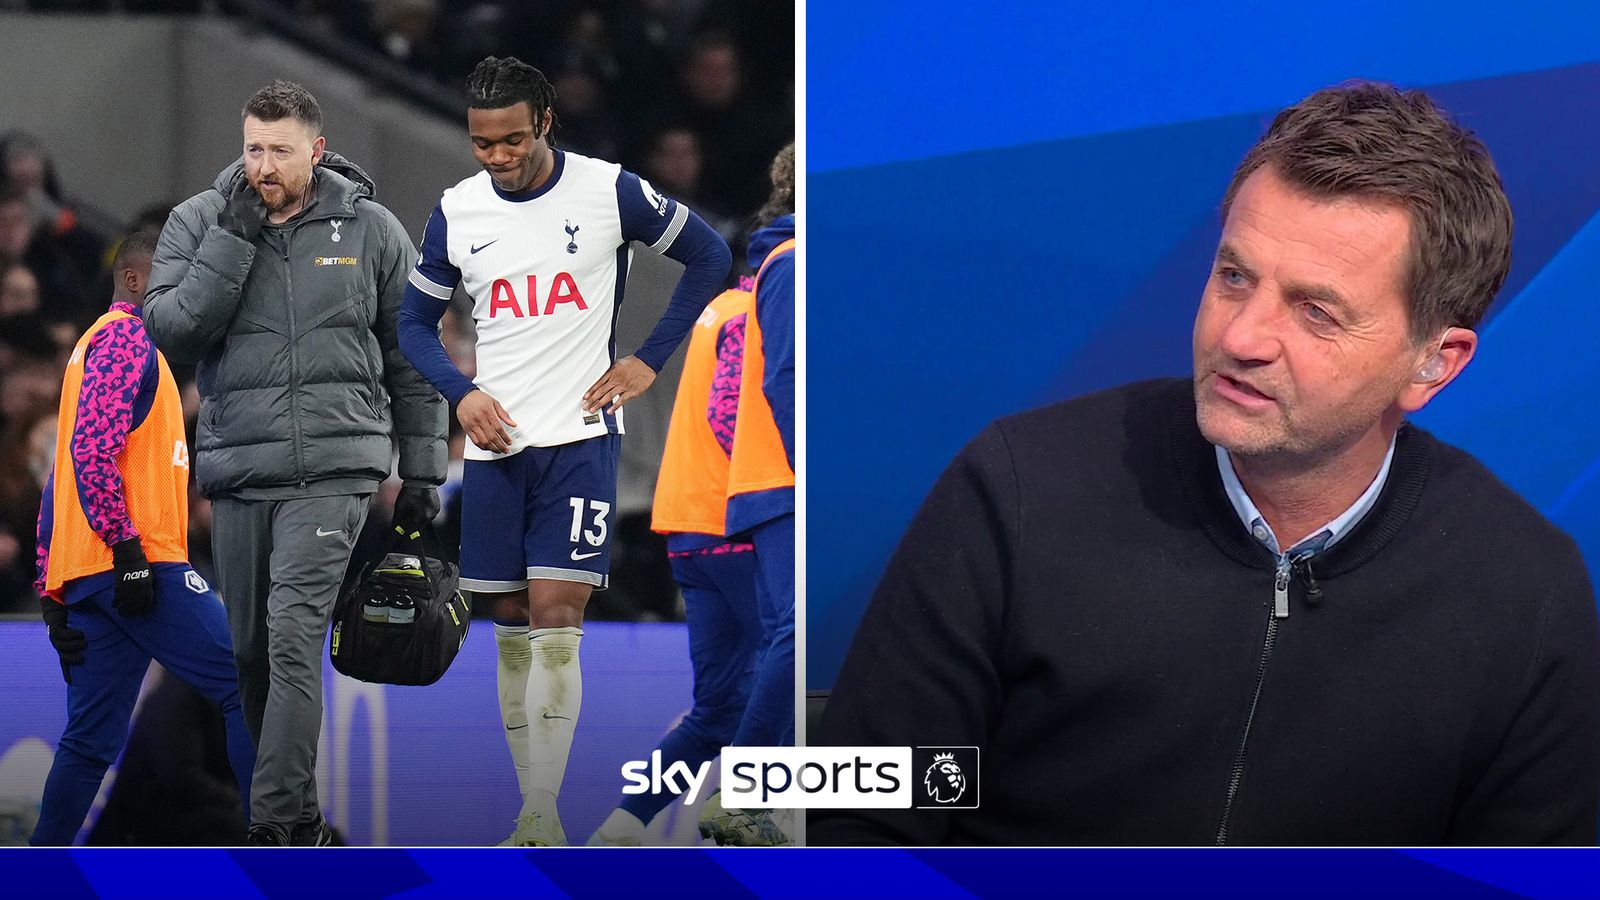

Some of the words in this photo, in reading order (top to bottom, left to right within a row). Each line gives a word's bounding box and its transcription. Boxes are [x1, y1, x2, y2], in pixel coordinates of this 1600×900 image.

[322, 256, 358, 266] BETMGM
[489, 271, 589, 318] AIA
[569, 496, 611, 547] 13
